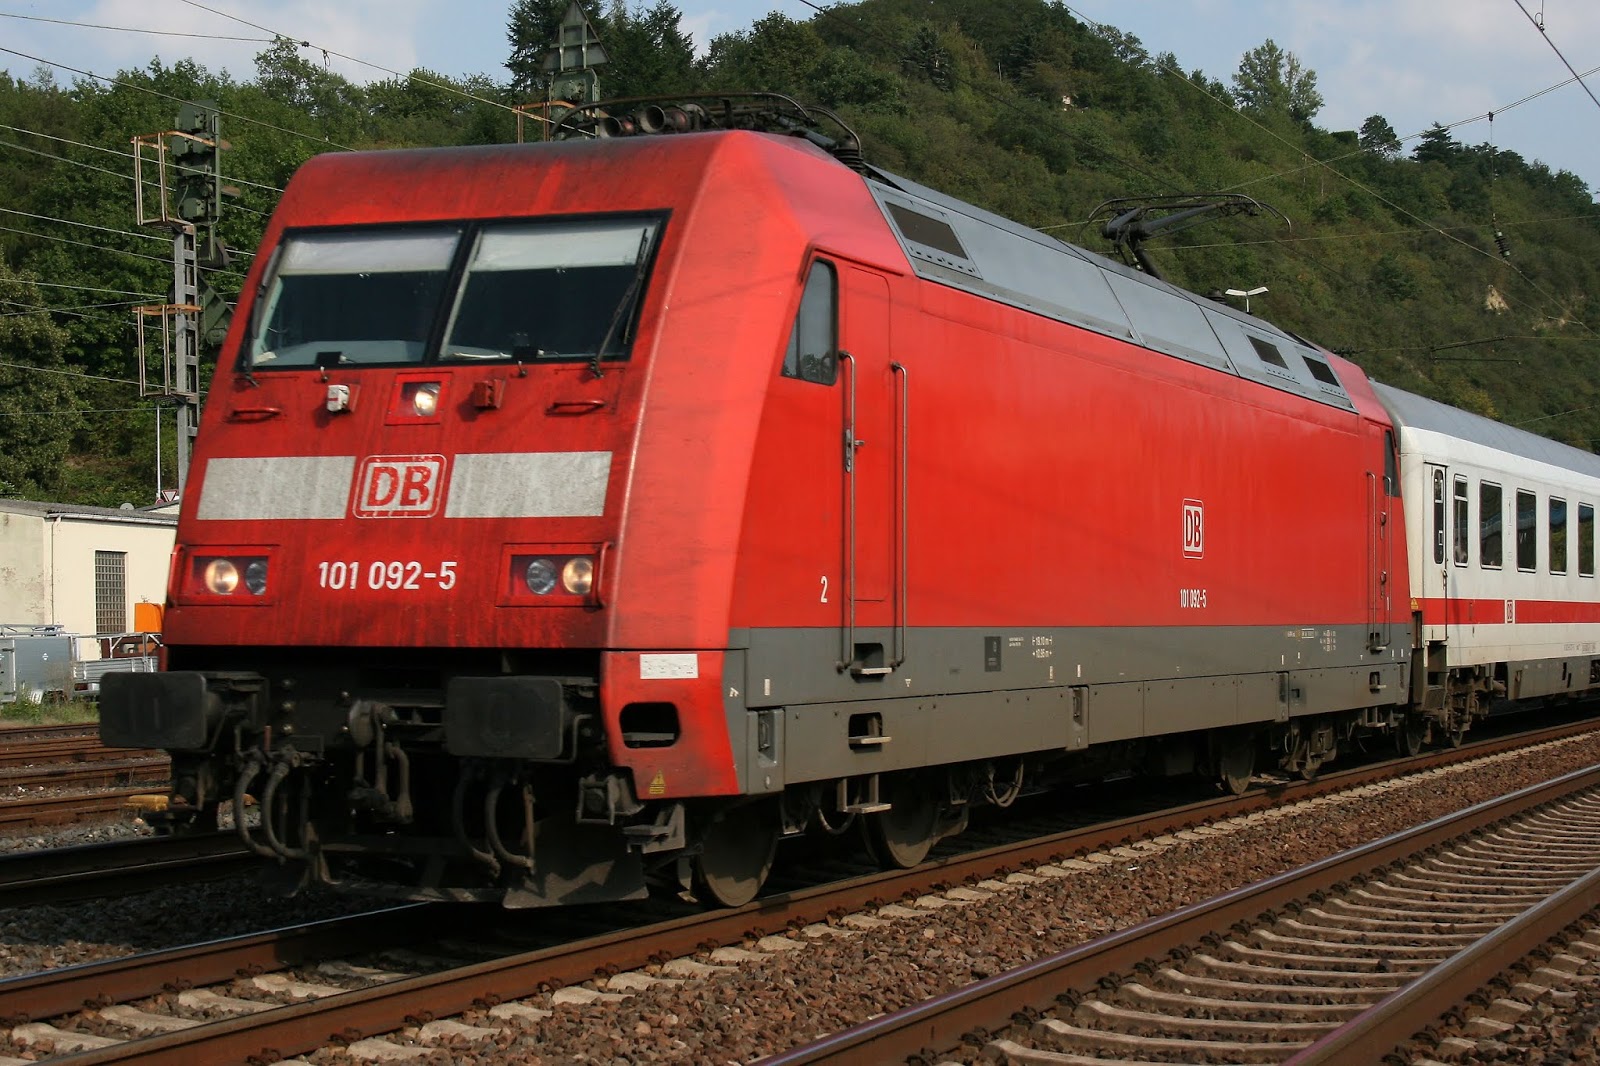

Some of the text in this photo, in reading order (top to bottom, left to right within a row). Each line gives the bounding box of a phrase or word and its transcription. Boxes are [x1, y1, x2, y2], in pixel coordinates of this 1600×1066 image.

[366, 465, 432, 507] DB
[1185, 509, 1202, 548] DB
[318, 561, 458, 590] 101 092-5
[820, 575, 828, 603] 2
[1180, 588, 1207, 609] 101 092-5
